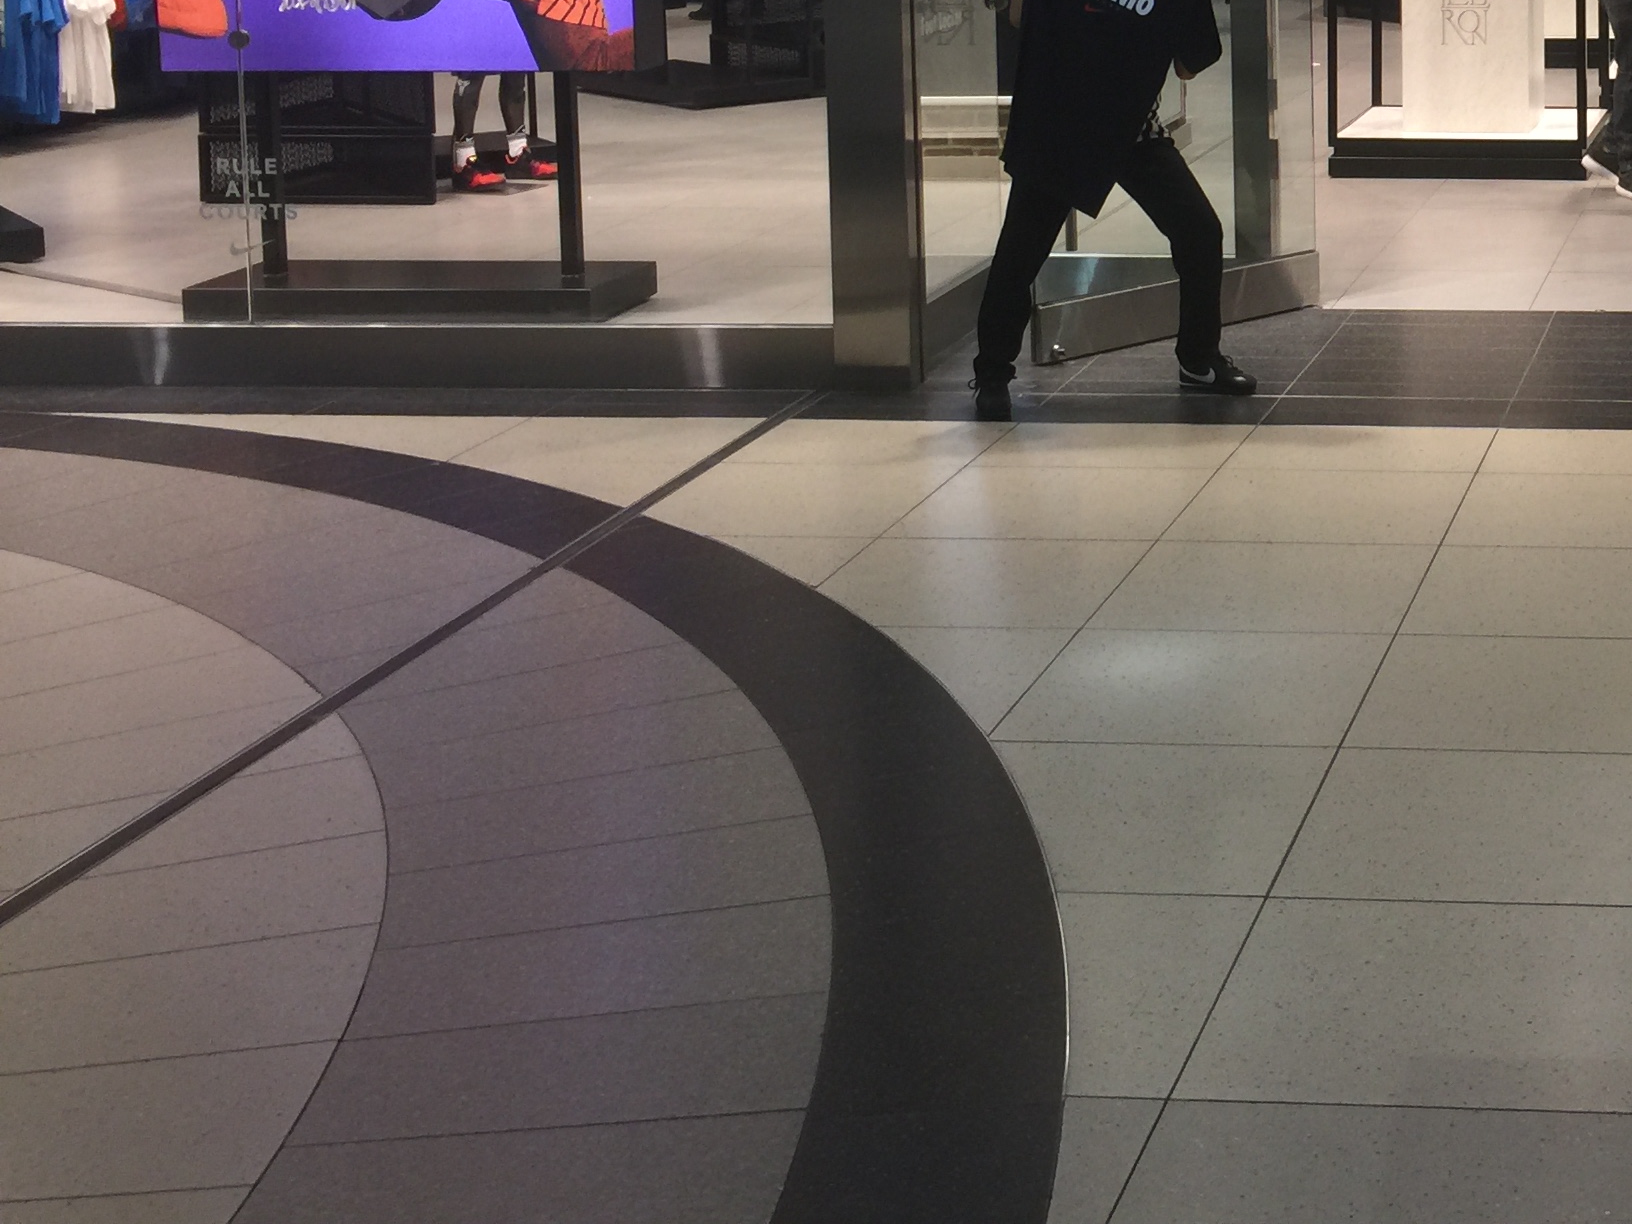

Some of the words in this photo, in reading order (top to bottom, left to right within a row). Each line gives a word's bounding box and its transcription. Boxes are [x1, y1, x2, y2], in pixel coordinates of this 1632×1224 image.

[216, 157, 277, 175] RULE
[225, 180, 270, 198] ALL
[200, 204, 298, 221] COURTS
